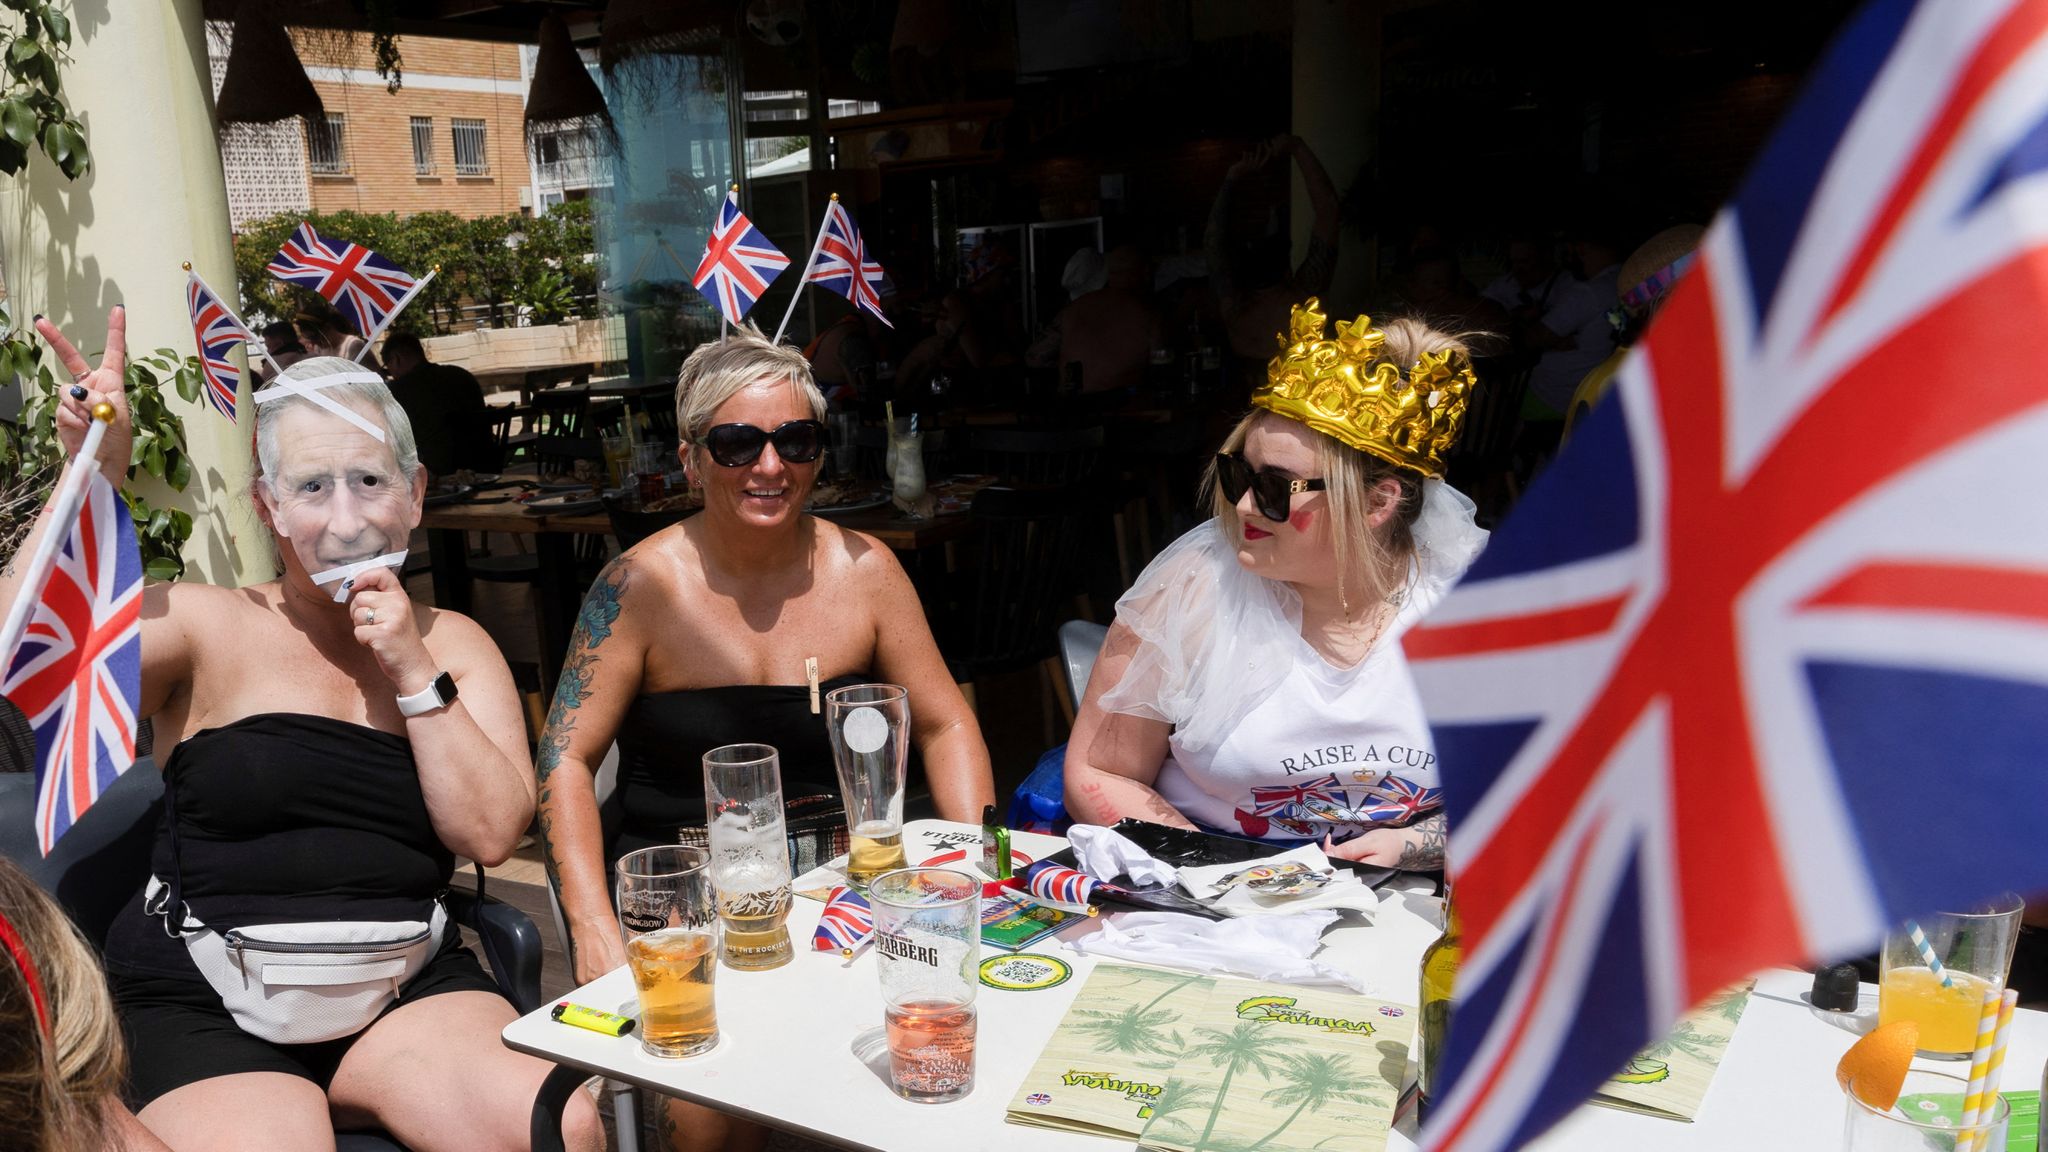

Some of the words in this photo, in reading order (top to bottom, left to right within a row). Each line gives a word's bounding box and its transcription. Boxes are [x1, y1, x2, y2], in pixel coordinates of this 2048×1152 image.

[1280, 745, 1356, 776] RAISE
[1362, 744, 1381, 762] A
[1388, 745, 1436, 771] CUP
[922, 831, 983, 845] STRELLA
[739, 946, 753, 954] THE
[878, 935, 938, 967] PARBERG
